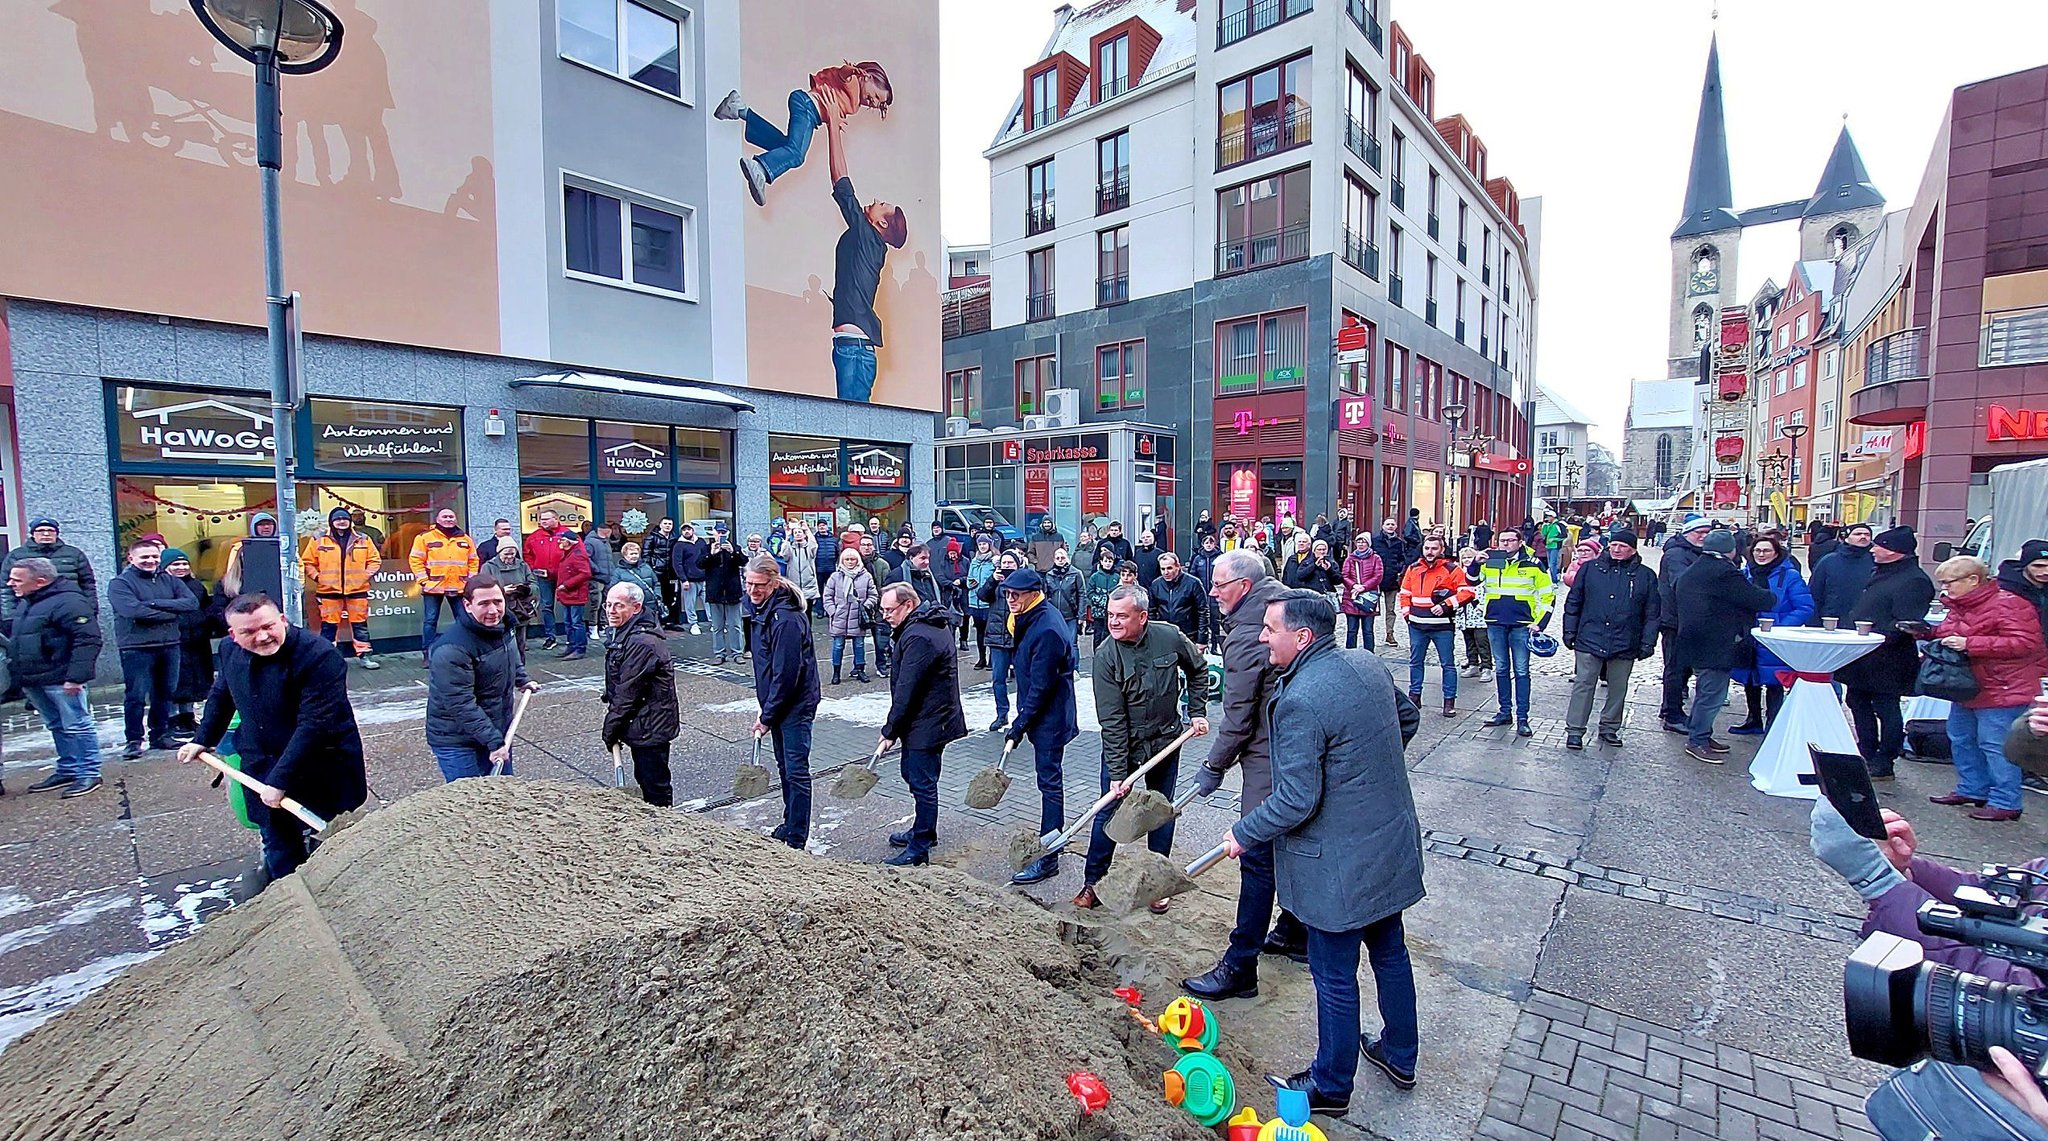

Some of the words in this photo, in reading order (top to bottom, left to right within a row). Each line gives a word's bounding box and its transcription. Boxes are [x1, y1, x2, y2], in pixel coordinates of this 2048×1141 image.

[1345, 401, 1364, 424] T
[1233, 411, 1252, 434] T
[322, 424, 420, 438] Ankommen
[423, 421, 453, 434] und
[140, 426, 277, 450] HaWoGe
[342, 440, 442, 458] Wohlfühlen!
[772, 452, 821, 462] Ankommen
[821, 449, 837, 459] und
[1027, 446, 1097, 464] Sparkasse
[606, 456, 663, 469] HaWoGe
[782, 463, 832, 475] Wohlfühlen!
[854, 464, 901, 477] HaWoGe
[530, 513, 585, 522] HoGe
[374, 571, 414, 583] Wohn
[367, 588, 408, 601] Style.
[368, 605, 416, 617] Leben.
